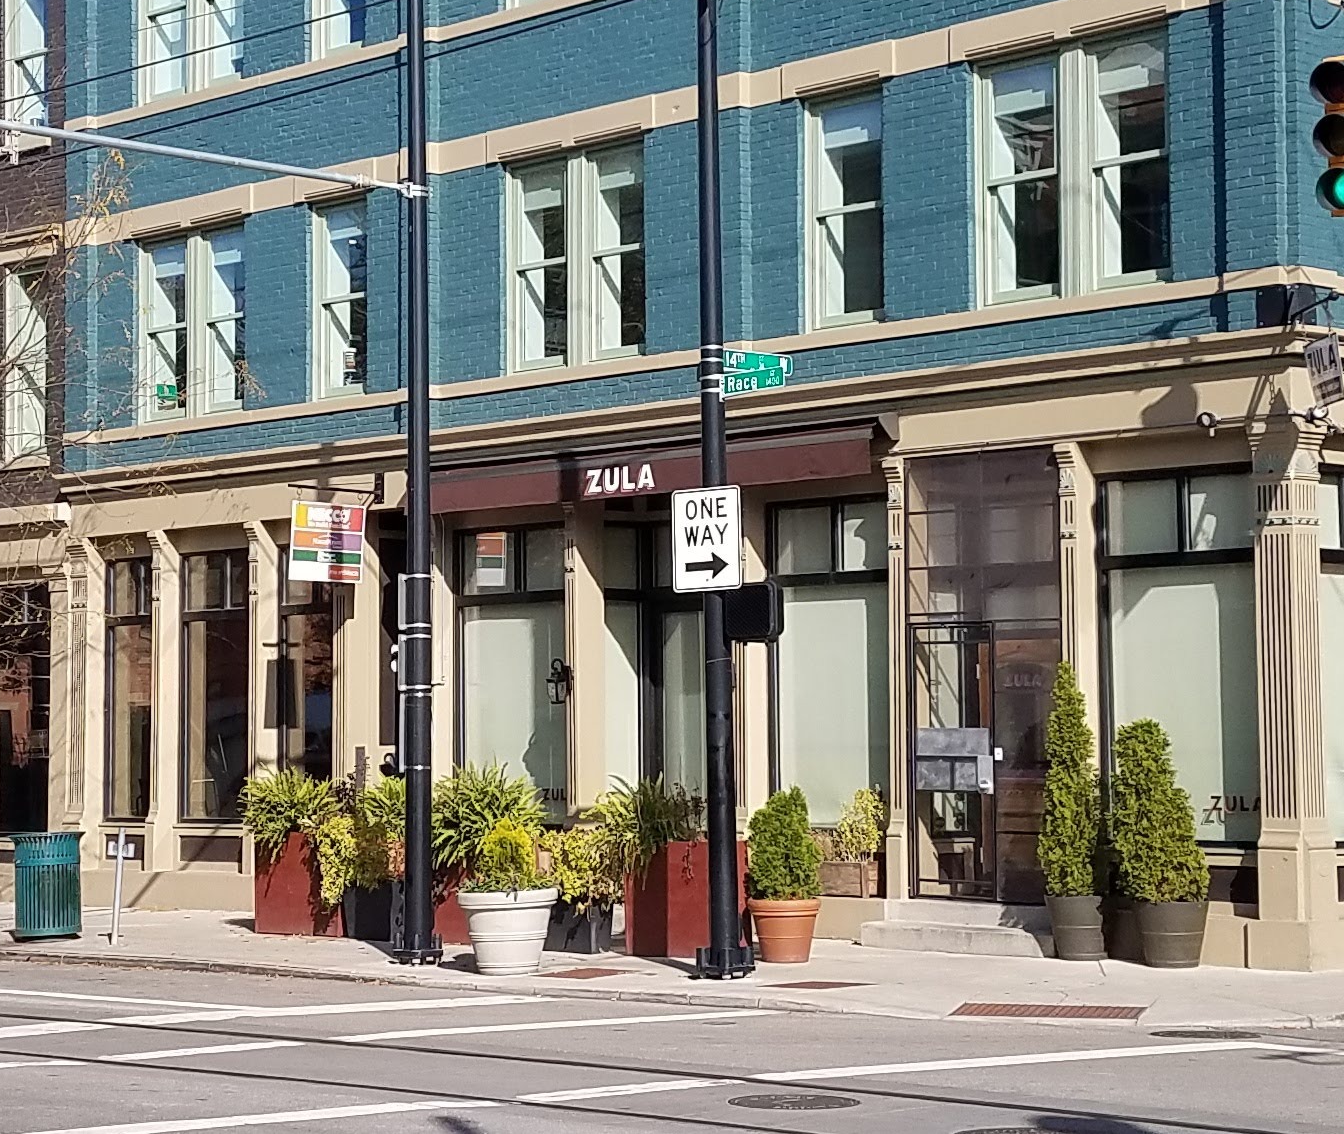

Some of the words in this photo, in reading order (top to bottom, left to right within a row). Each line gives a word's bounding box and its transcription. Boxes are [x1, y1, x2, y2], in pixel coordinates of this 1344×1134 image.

[727, 376, 758, 392] Race
[584, 463, 656, 497] ZULA
[685, 497, 727, 520] ONE
[684, 523, 728, 547] WAY
[542, 788, 567, 801] ZUL
